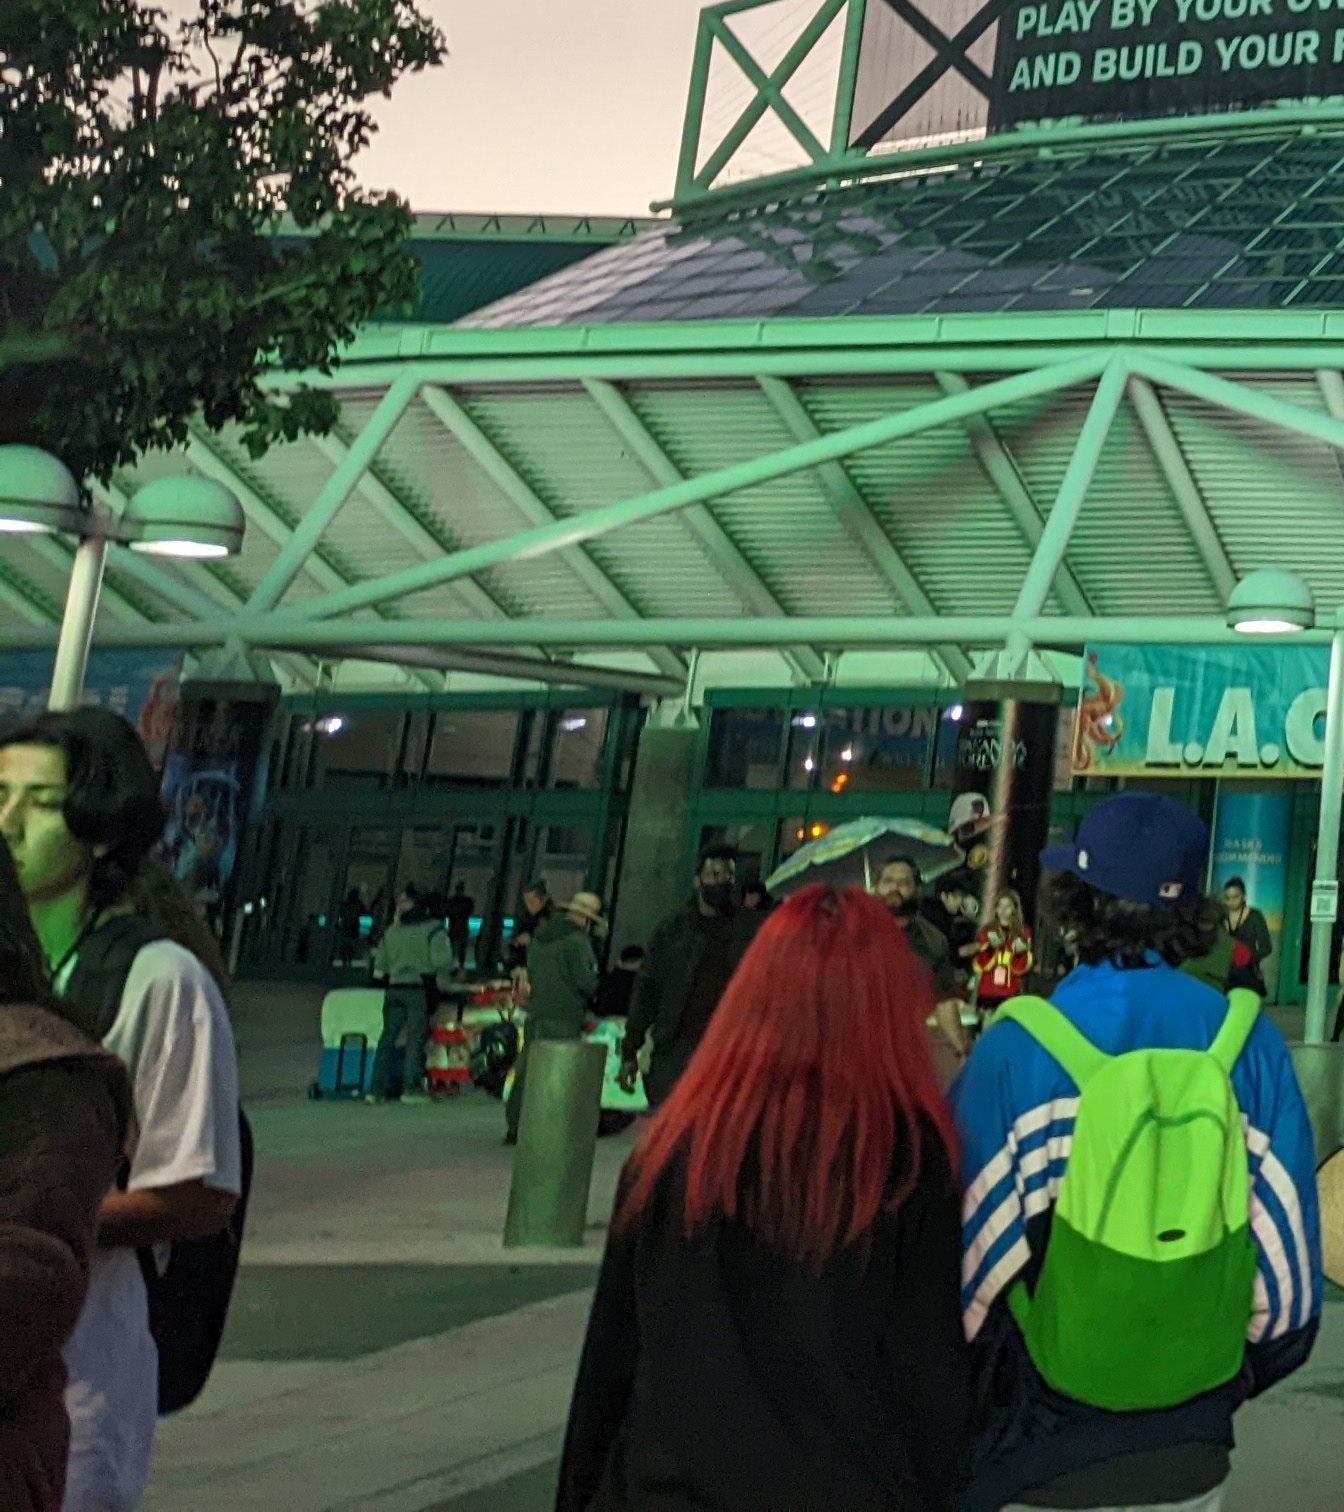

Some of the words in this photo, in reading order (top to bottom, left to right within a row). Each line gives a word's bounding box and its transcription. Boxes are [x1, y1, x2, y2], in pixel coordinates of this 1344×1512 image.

[1009, 54, 1082, 92] AND
[1092, 42, 1203, 83] BUILD
[1215, 31, 1320, 71] YOUR
[1145, 687, 1280, 769] L.A.
